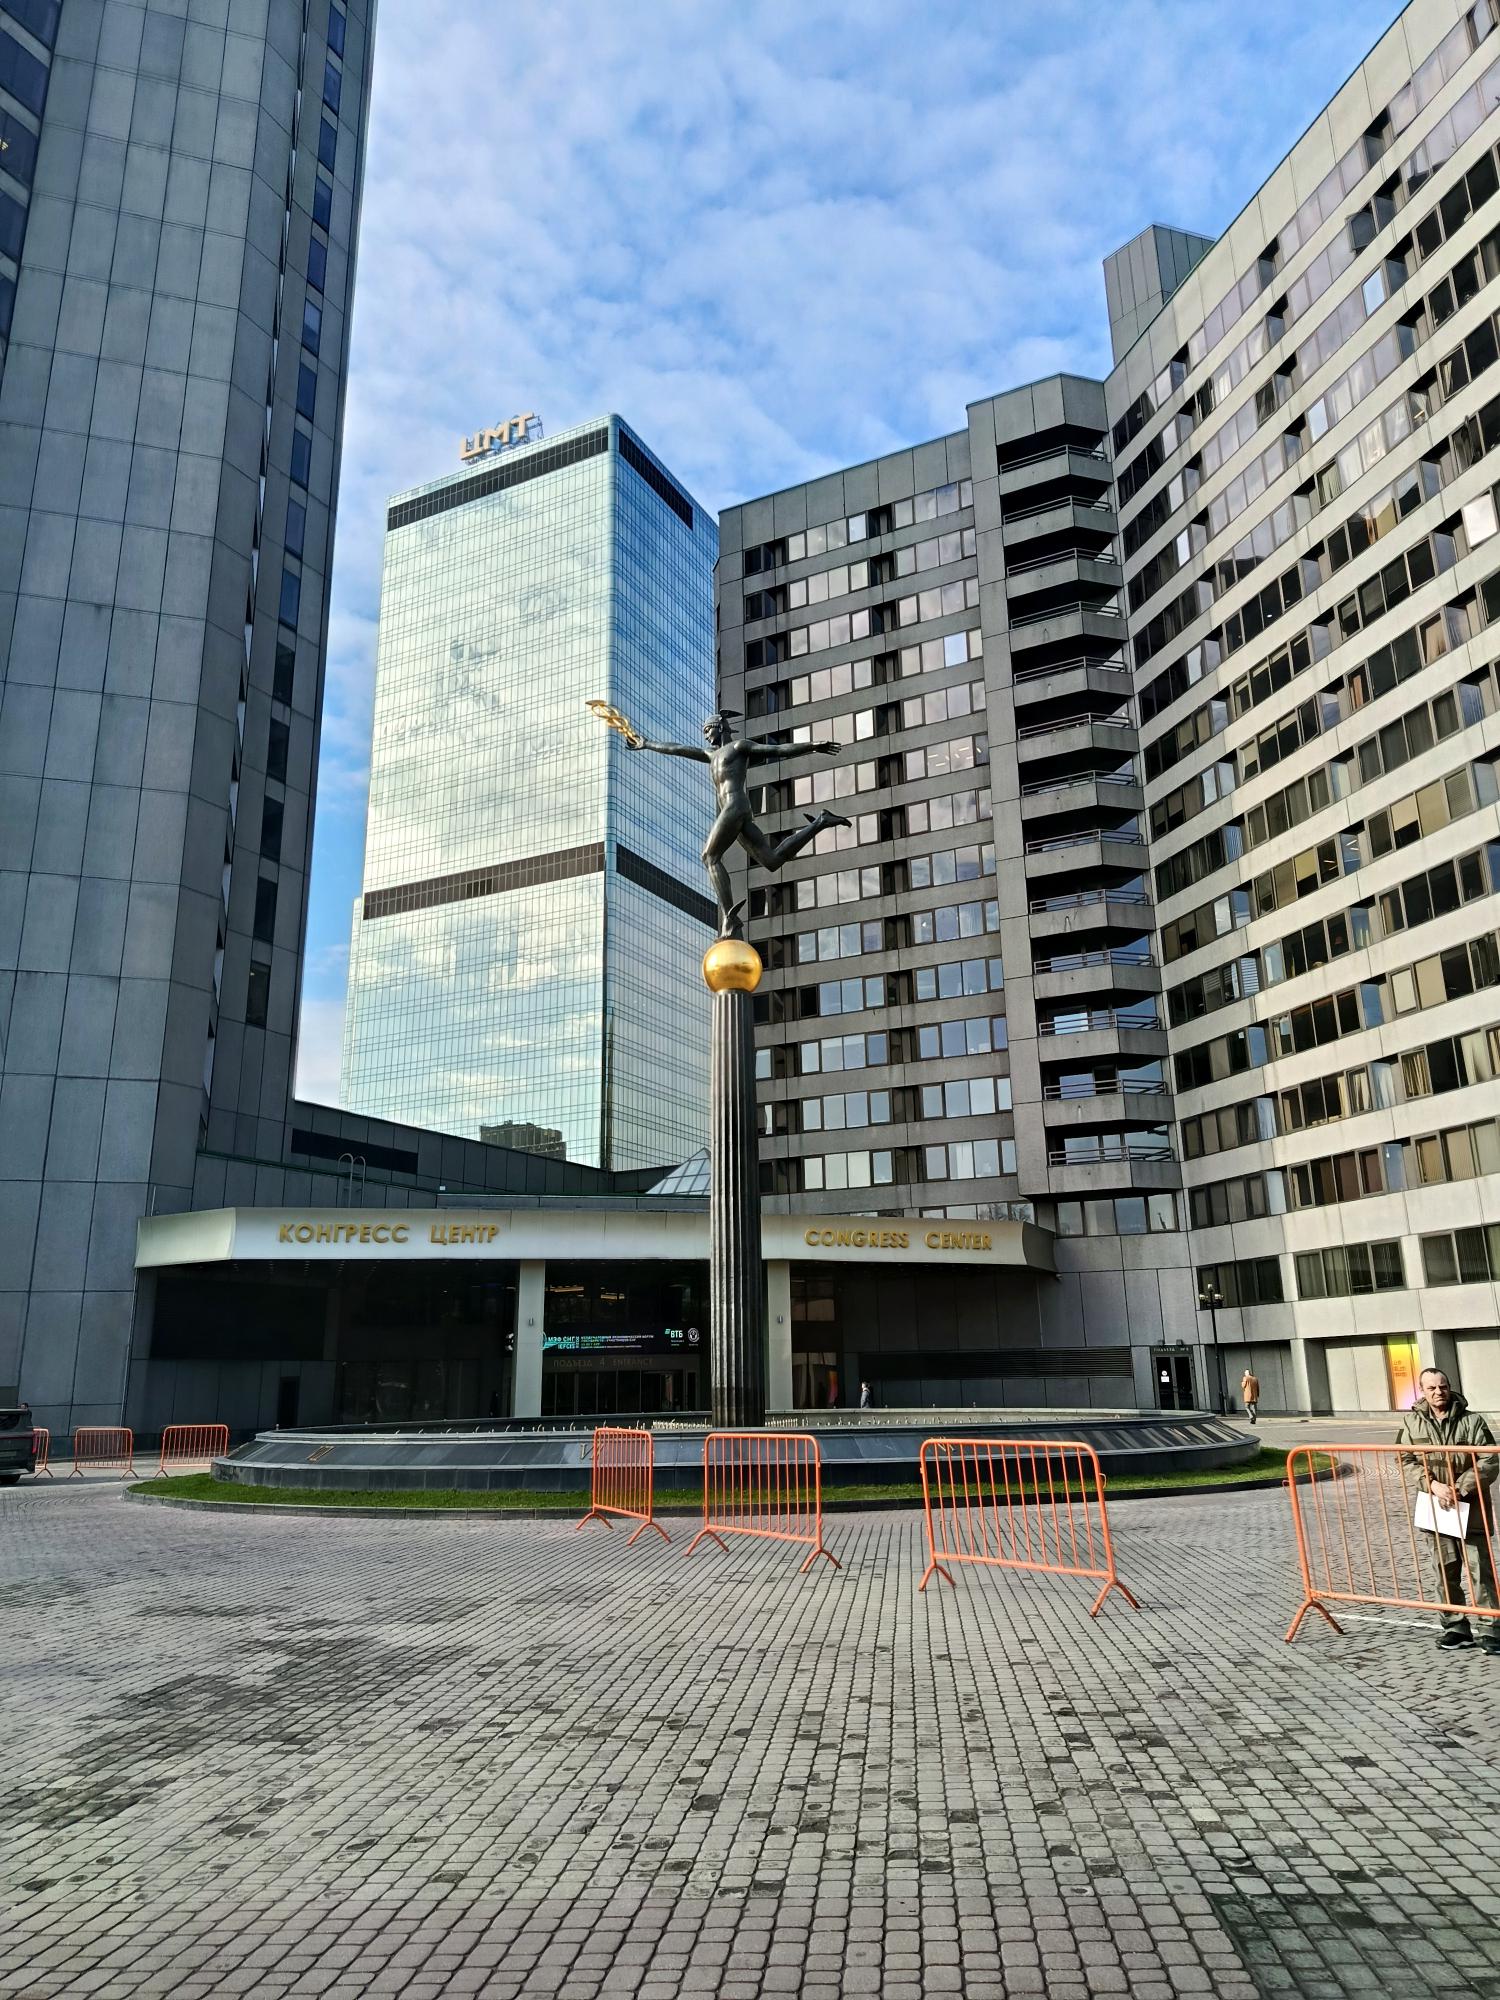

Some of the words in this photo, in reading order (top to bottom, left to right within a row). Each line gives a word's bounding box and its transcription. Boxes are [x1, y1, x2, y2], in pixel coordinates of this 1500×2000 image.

[460, 411, 535, 460] ЦМТ
[279, 1223, 410, 1244] КОНГРЕСС
[430, 1224, 500, 1246] ЦЕНТР
[805, 1228, 910, 1249] CONGRESS
[925, 1231, 992, 1250] CENTER
[670, 1330, 684, 1338] ВТБ
